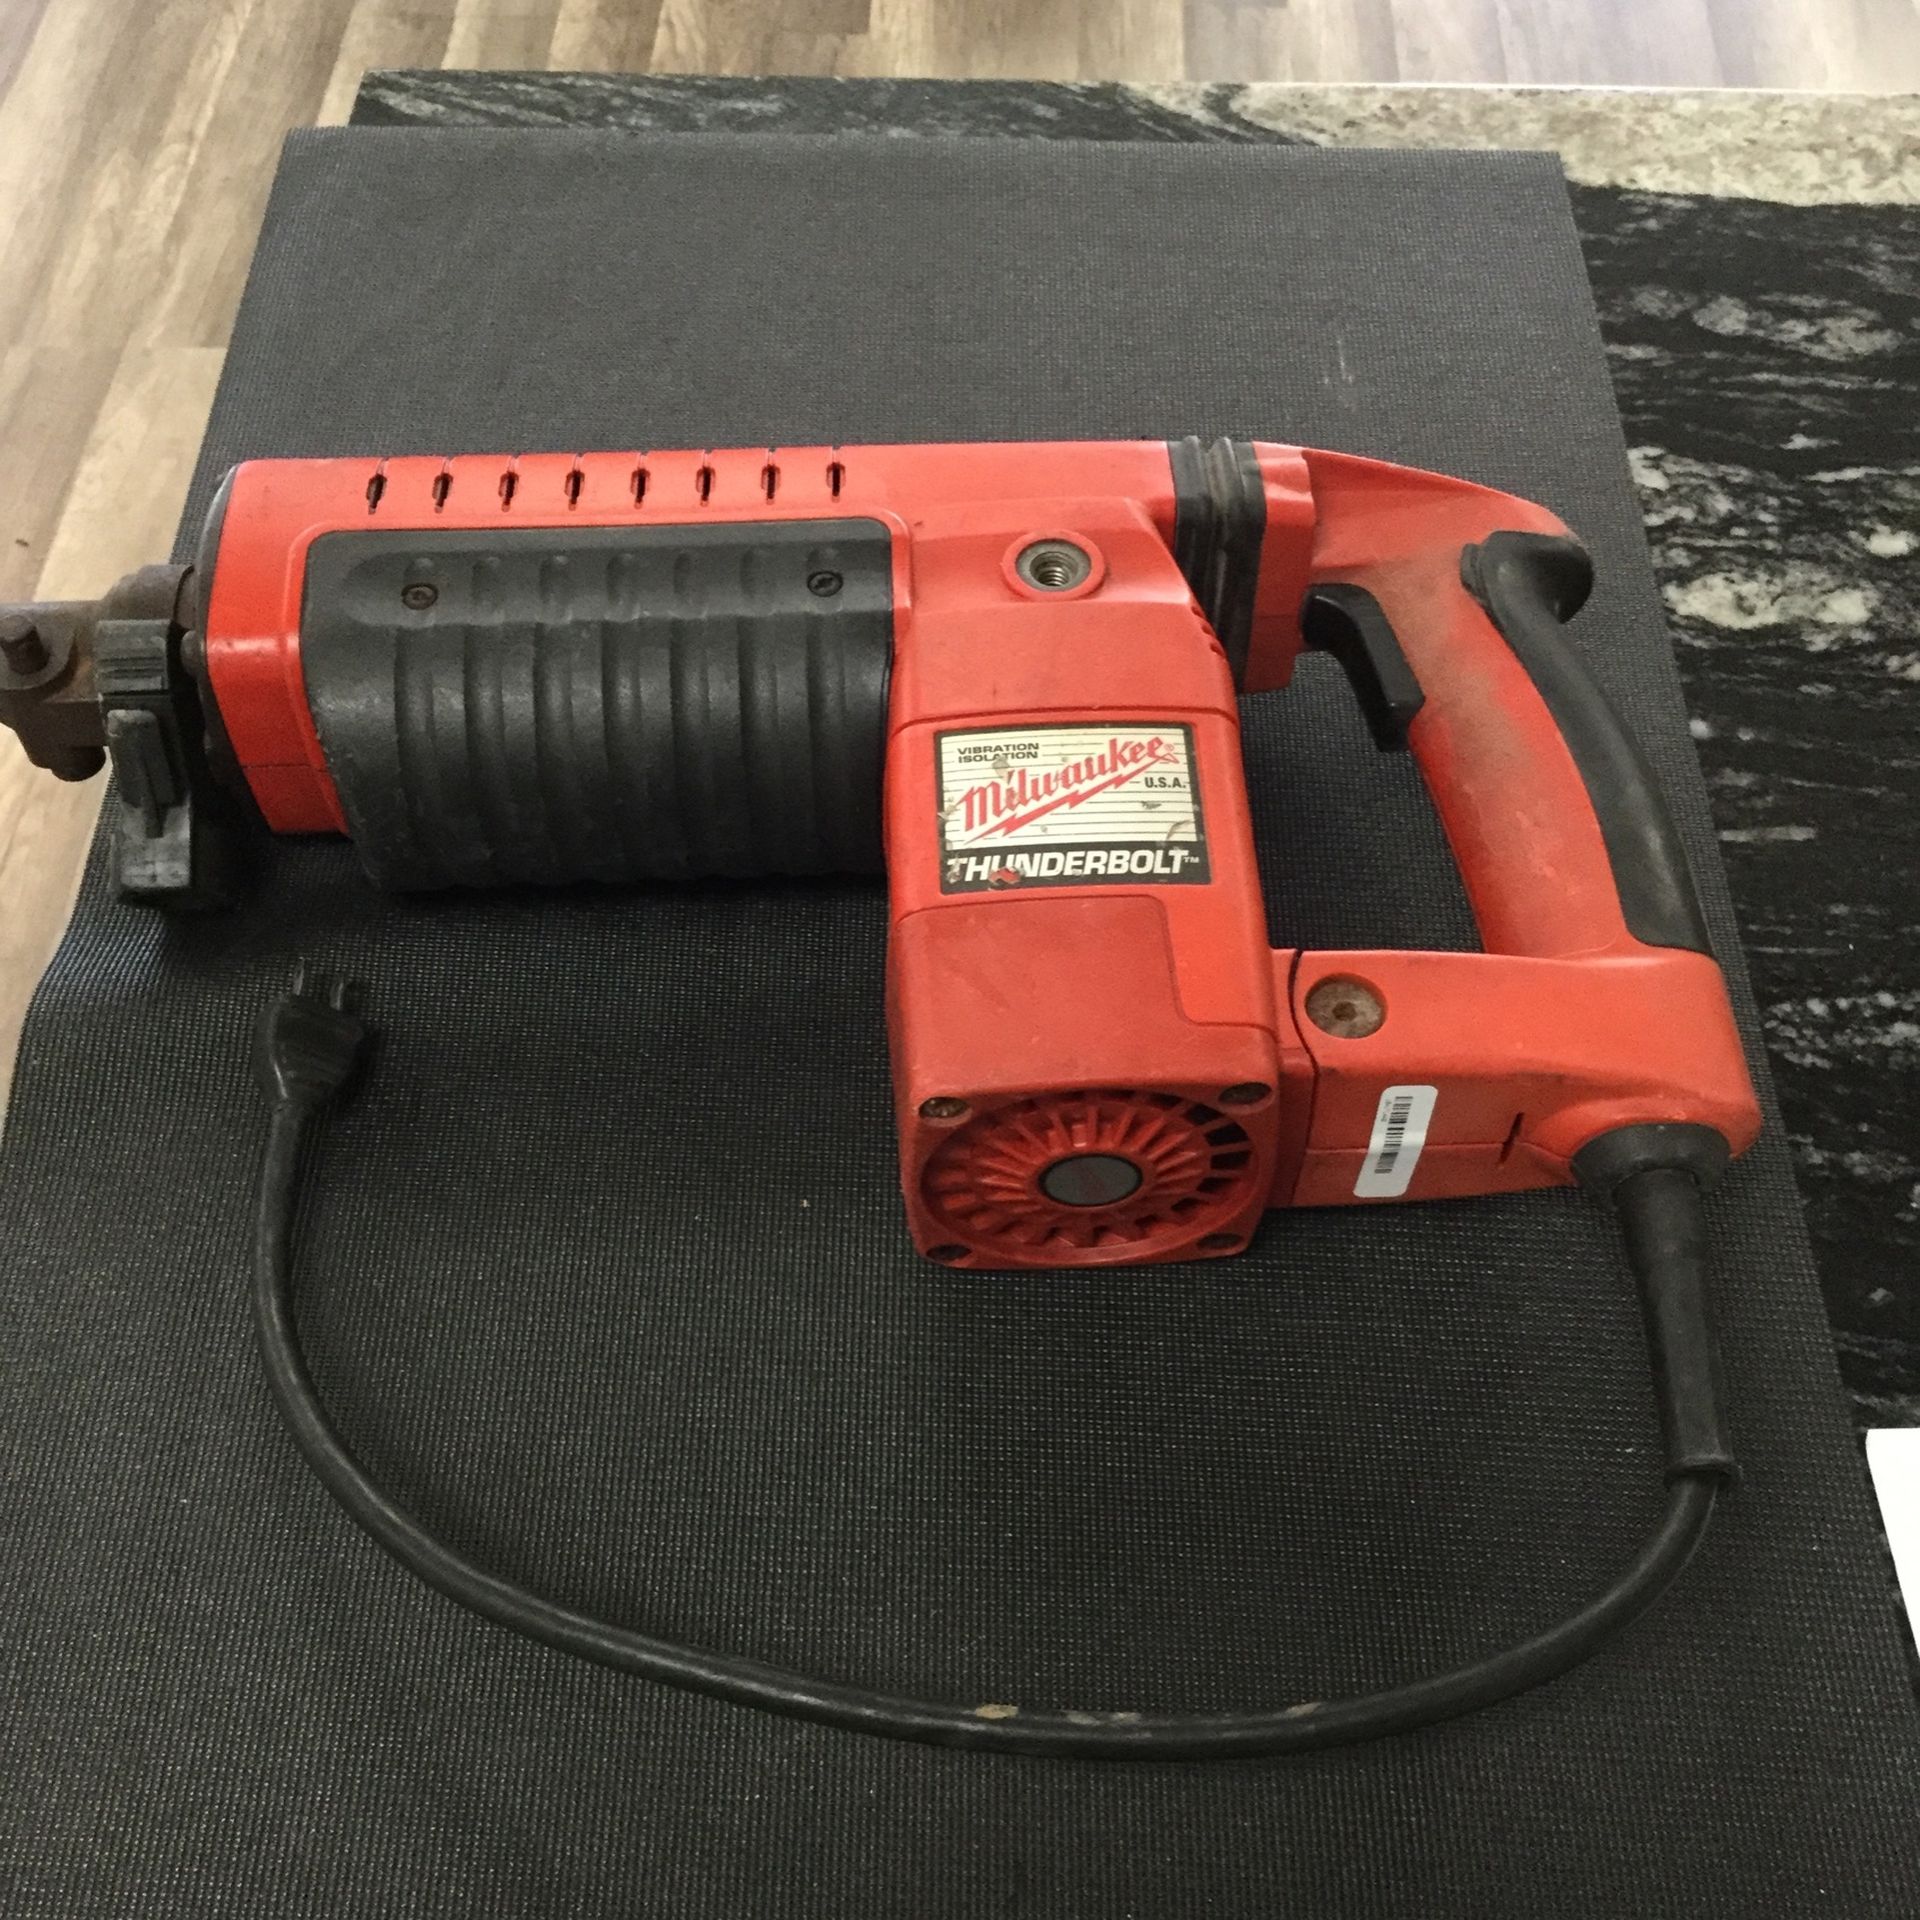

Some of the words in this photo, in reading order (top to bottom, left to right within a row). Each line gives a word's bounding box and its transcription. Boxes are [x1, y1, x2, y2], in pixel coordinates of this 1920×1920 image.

[957, 742, 1040, 755] VIBRATION
[958, 751, 1039, 763] ISOLATION
[955, 736, 1165, 832] Milwaukee
[1145, 776, 1187, 789] U.S.A.
